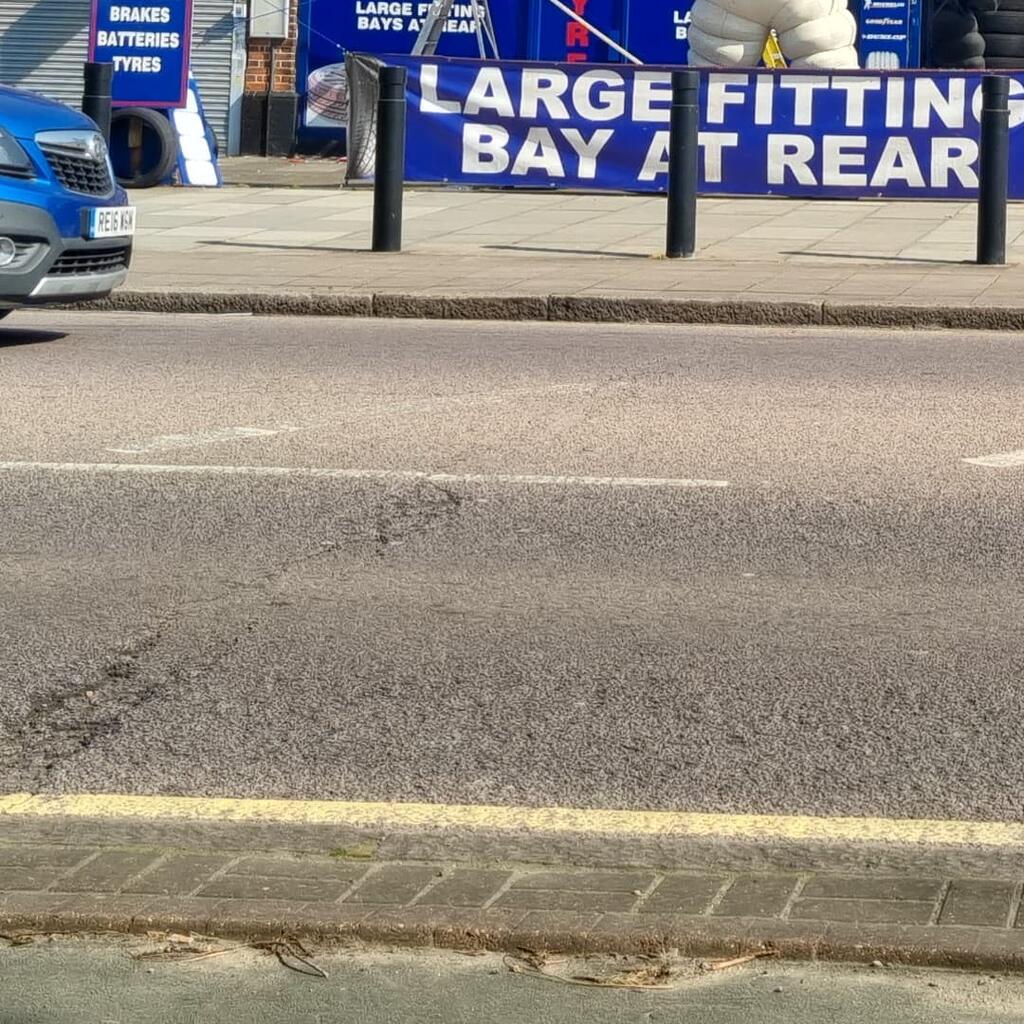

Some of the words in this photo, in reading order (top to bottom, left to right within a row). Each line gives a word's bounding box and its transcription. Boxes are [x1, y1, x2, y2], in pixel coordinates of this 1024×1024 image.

[109, 6, 171, 23] BRAKES
[356, 1, 413, 16] LARGE
[357, 17, 404, 31] BAYS
[97, 30, 181, 49] BATTERIES
[112, 56, 162, 73] TYRES
[419, 63, 672, 123] LARGE
[461, 123, 615, 180] BAY
[637, 130, 738, 183] AT
[767, 132, 980, 188] REAR
